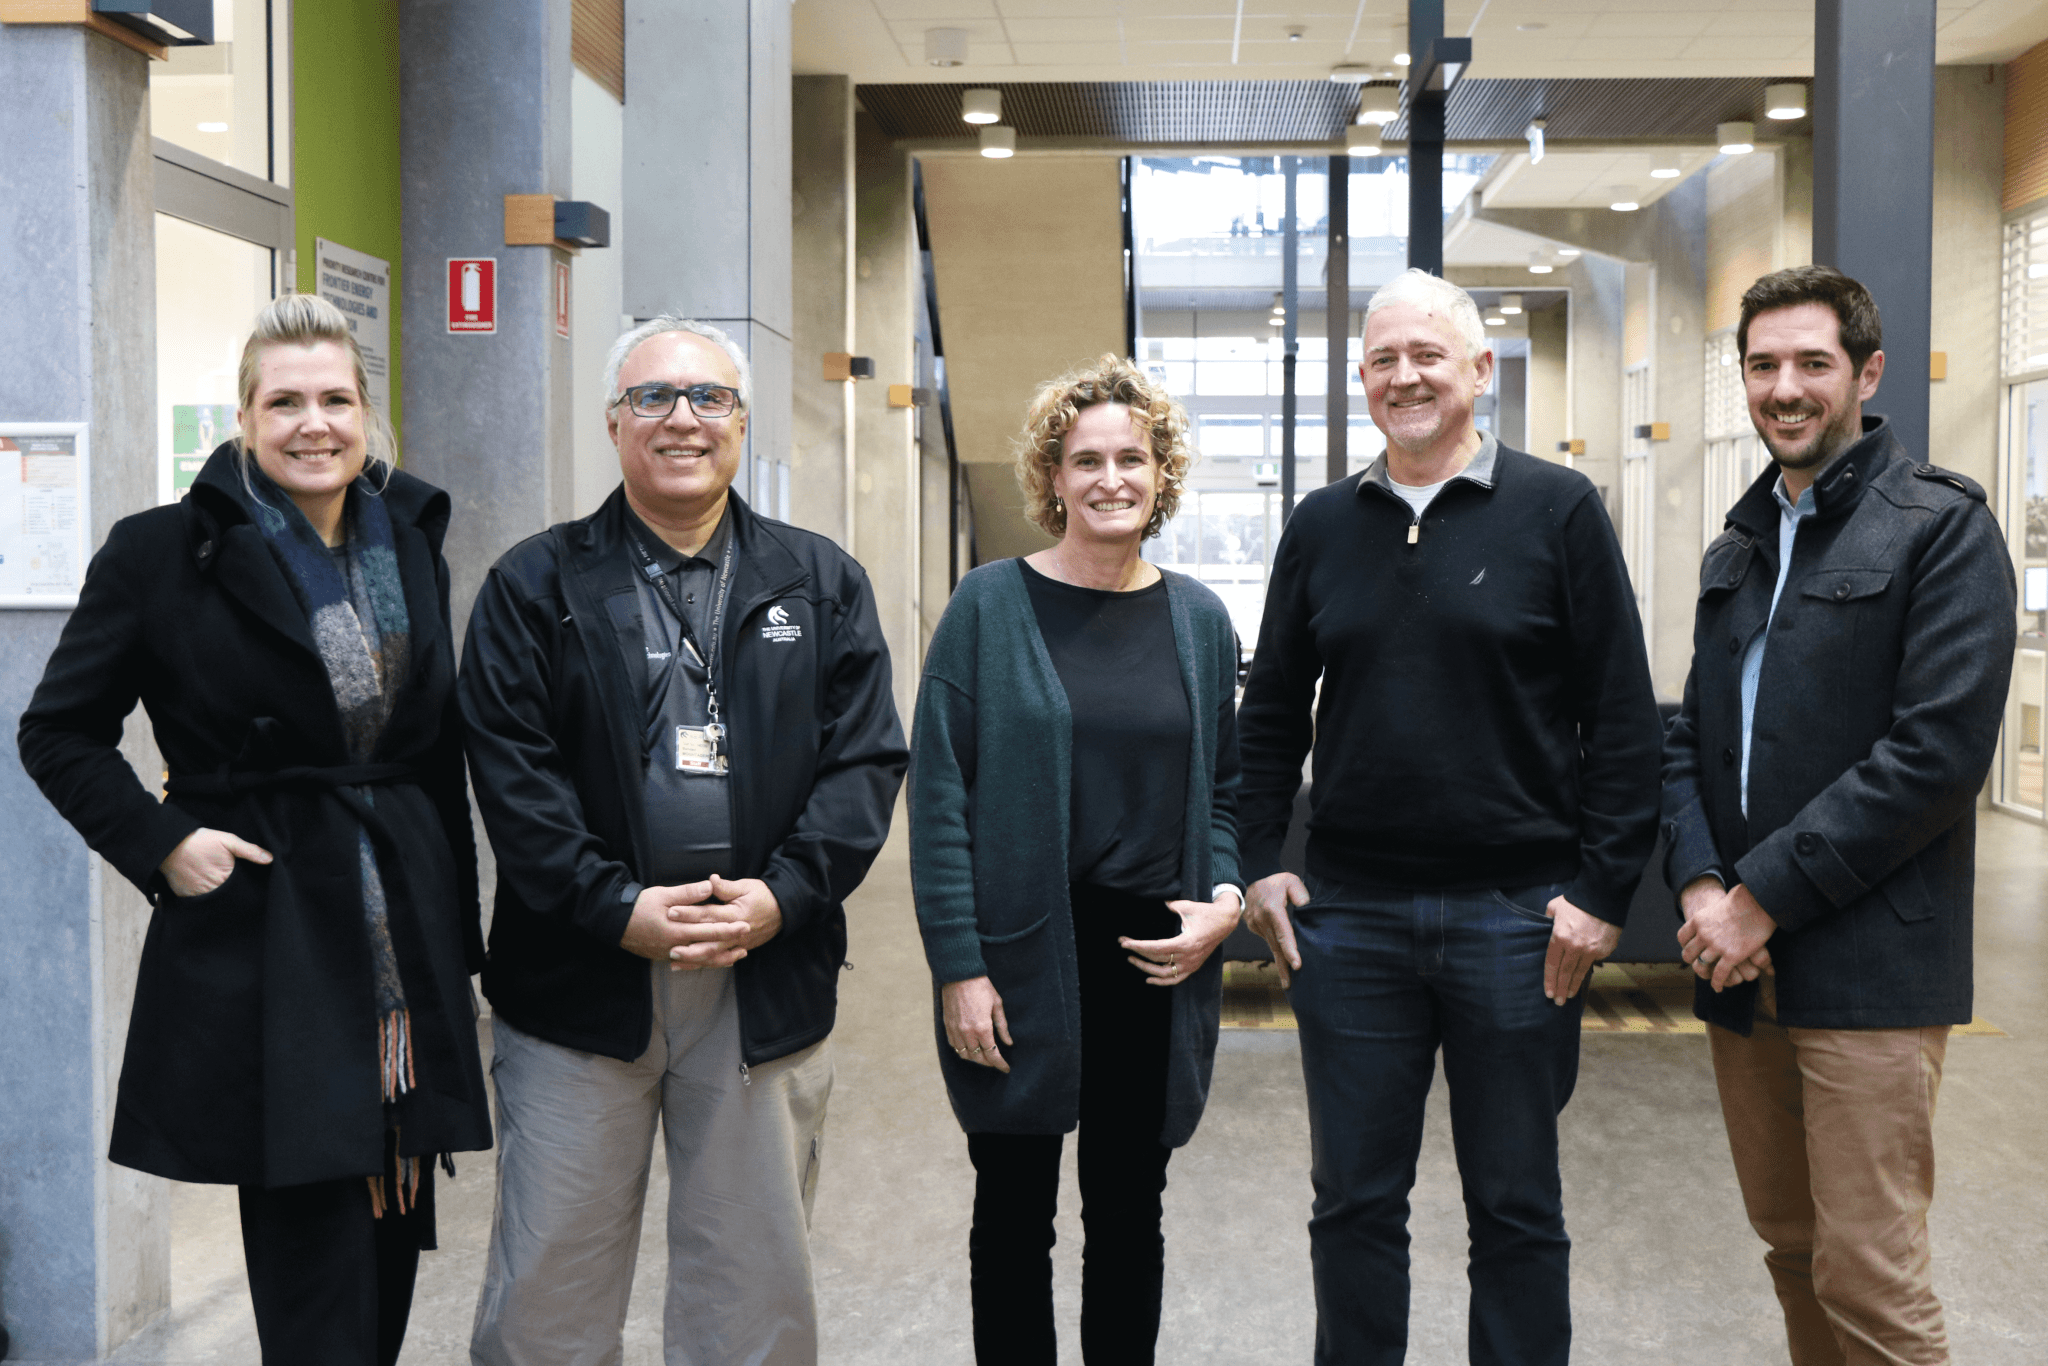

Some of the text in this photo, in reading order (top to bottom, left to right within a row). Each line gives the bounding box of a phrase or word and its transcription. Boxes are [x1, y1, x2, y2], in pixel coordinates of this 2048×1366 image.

[323, 272, 373, 299] FRONTIER ENERGY
[720, 554, 731, 580] Newcastle
[720, 580, 726, 588] of
[714, 588, 726, 615] University
[712, 615, 720, 625] The
[762, 630, 802, 638] NEWCASTLE
